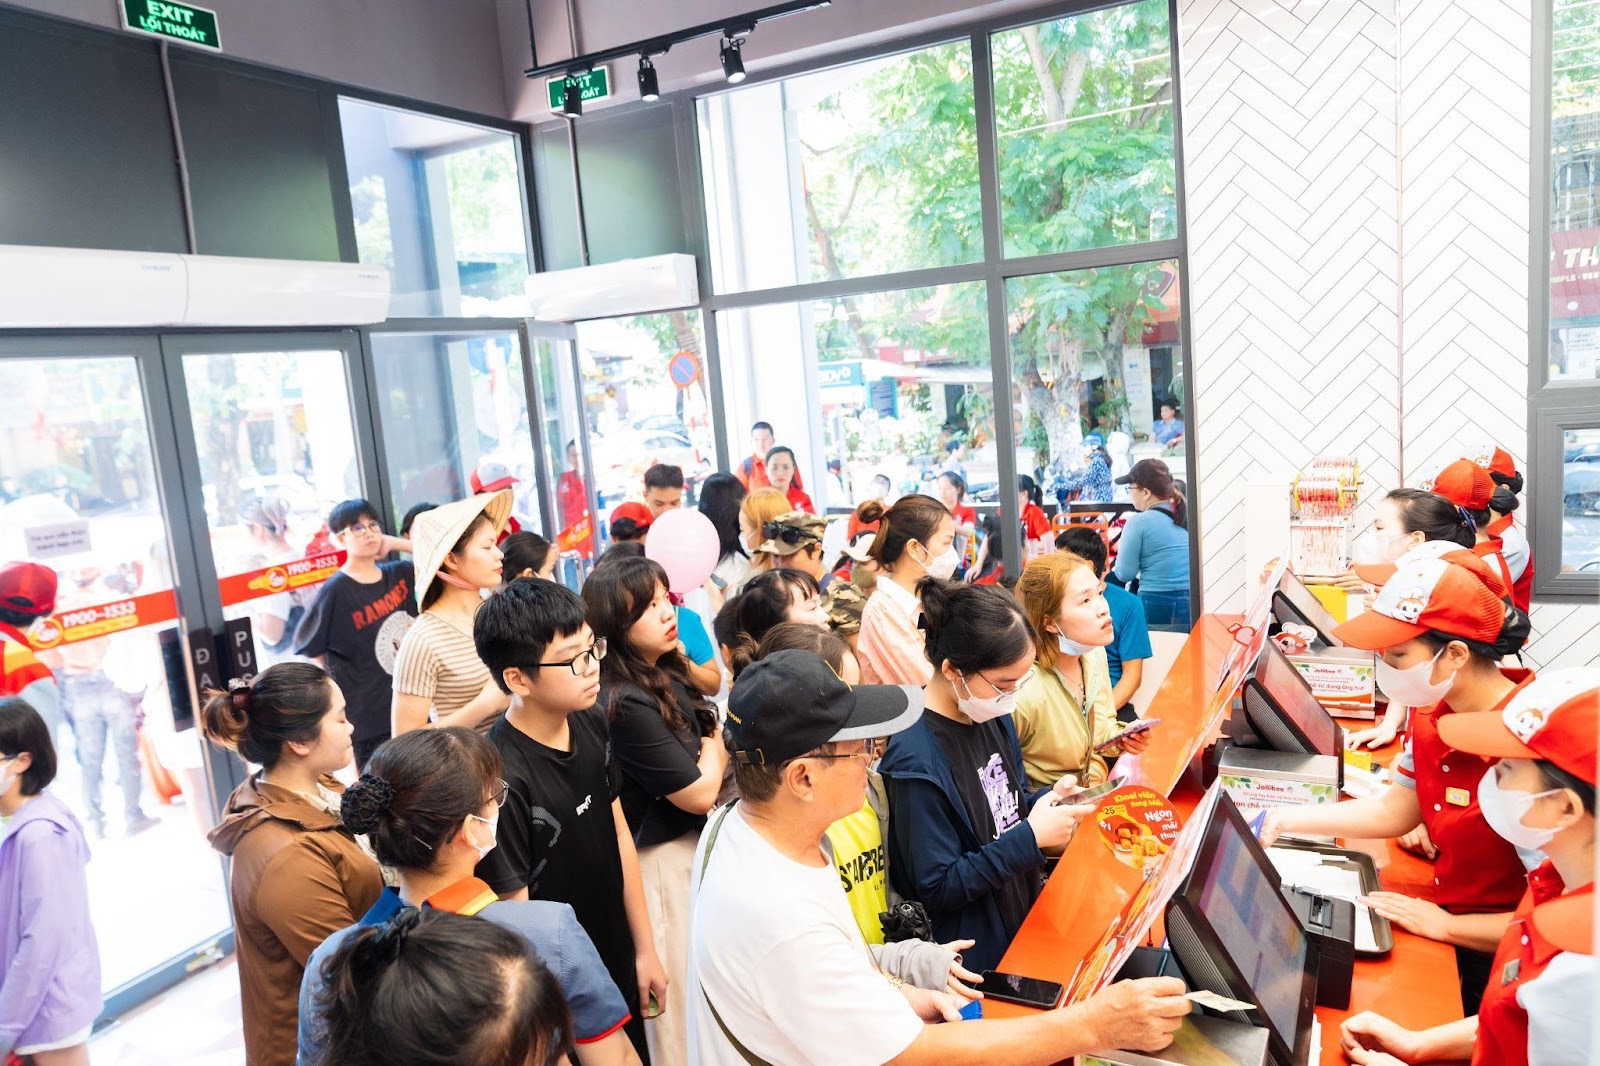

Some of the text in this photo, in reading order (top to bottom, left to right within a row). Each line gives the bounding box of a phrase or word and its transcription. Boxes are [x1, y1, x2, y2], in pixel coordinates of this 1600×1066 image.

[147, 0, 194, 25] EXIT
[287, 555, 338, 576] 1900-1533
[61, 601, 136, 628] 1900-1533
[351, 579, 408, 630] RAMONES
[235, 630, 254, 683] PUS
[1114, 792, 1137, 803] Khoai
[1256, 784, 1285, 792] Jollibee
[1103, 807, 1115, 815] 25
[1144, 810, 1174, 822] Ngon
